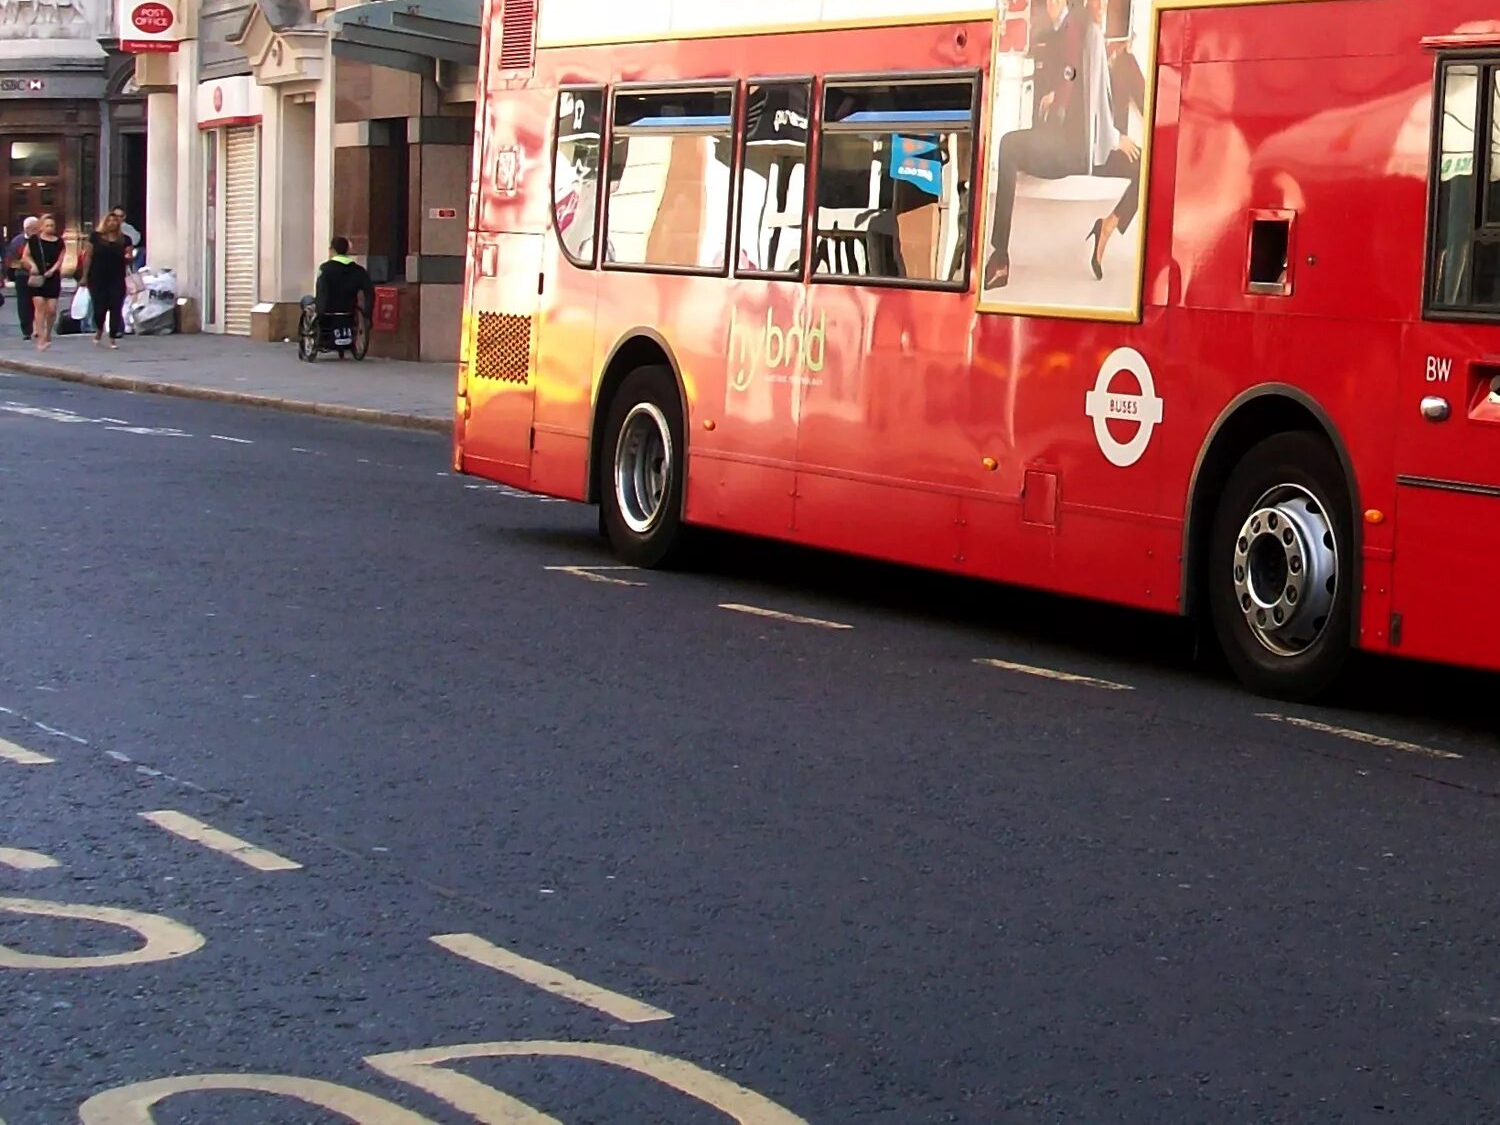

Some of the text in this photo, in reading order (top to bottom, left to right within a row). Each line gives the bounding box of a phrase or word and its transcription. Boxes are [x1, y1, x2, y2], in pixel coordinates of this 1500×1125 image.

[140, 7, 165, 17] POST
[134, 16, 168, 27] OFFICE
[1425, 355, 1453, 383] BW
[1109, 398, 1138, 415] BUSES
